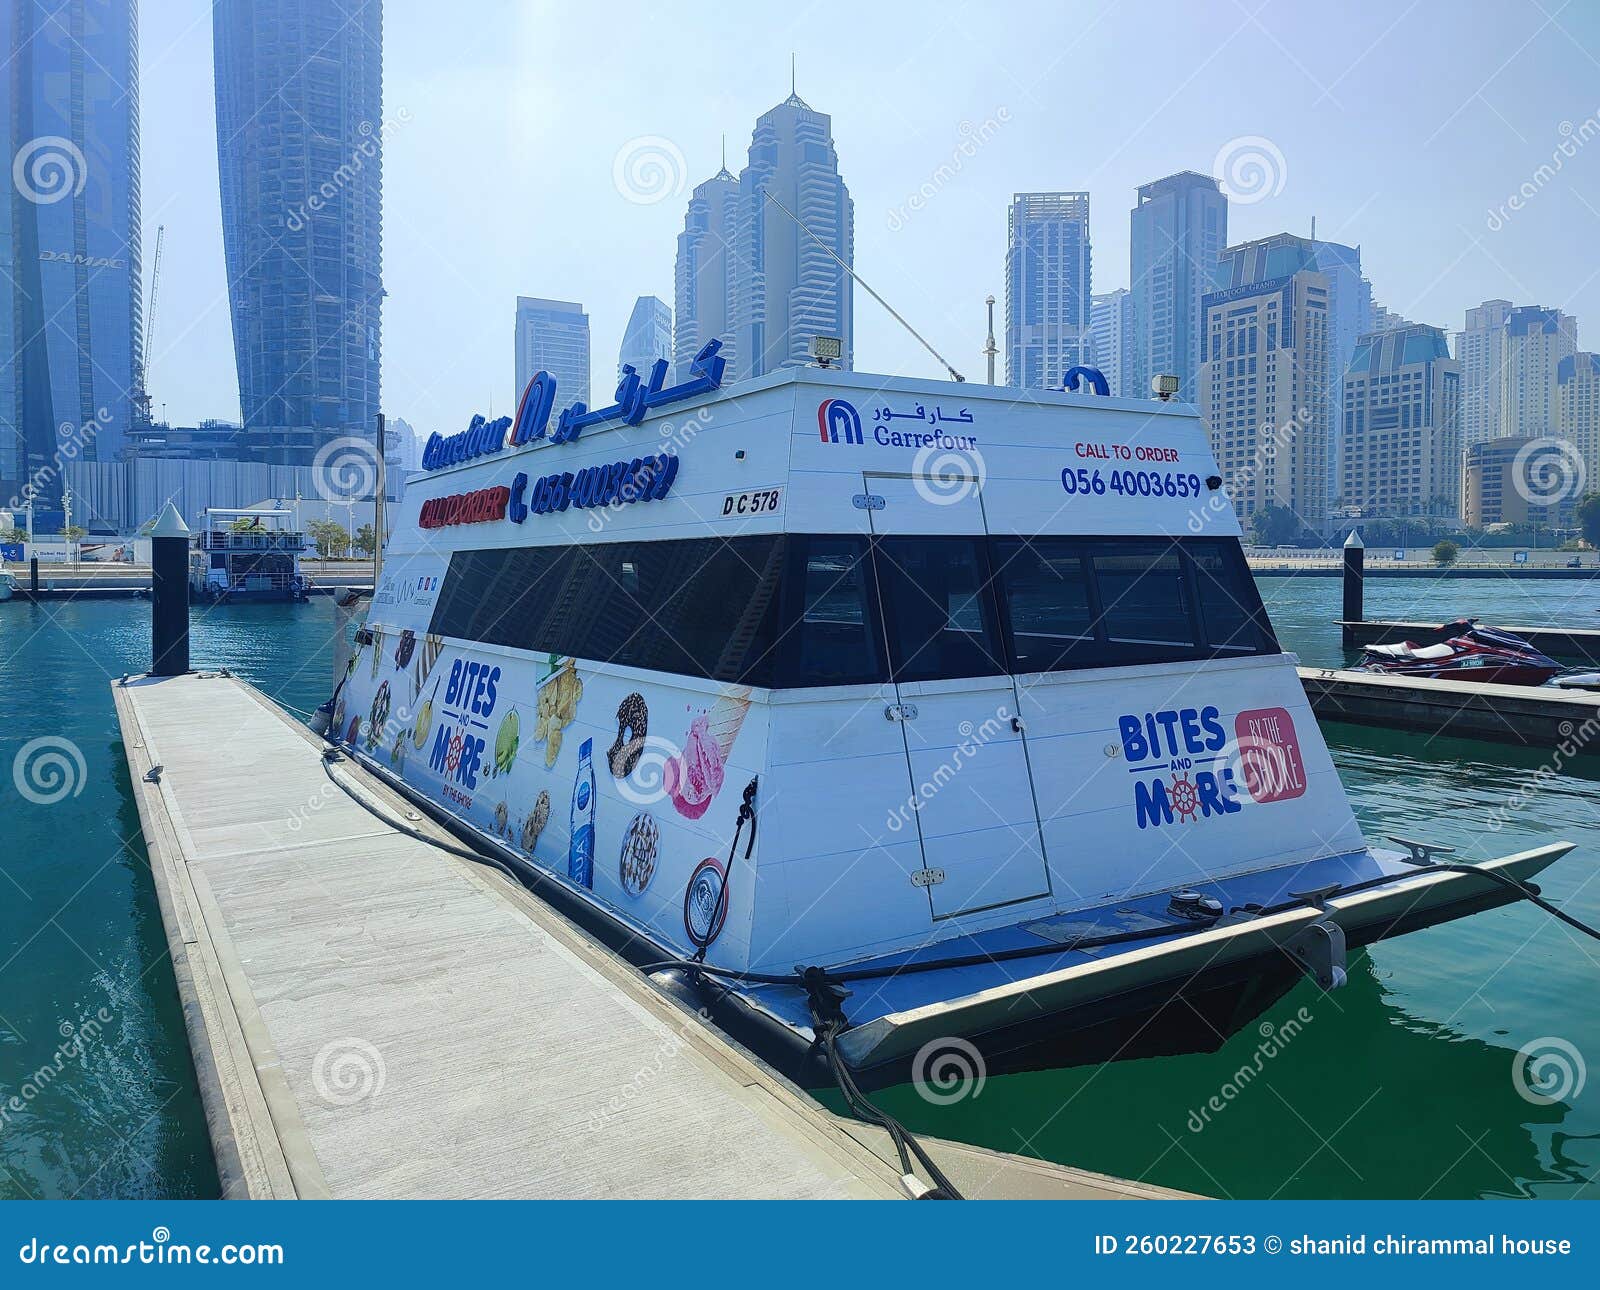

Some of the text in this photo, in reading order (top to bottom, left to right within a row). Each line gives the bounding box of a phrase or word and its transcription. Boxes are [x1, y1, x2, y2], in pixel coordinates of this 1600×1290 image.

[39, 250, 129, 269] DAMAC
[873, 402, 974, 424] كارفور
[874, 426, 977, 450] Carrefour
[1075, 443, 1180, 462] CALL TO ORDER
[531, 472, 574, 514] 056
[1061, 467, 1200, 498] 056 4003659
[751, 491, 779, 512] 578
[445, 659, 500, 718] BITES
[458, 714, 470, 727] AND
[1249, 716, 1283, 746] BY THE
[1119, 706, 1226, 762] BITES
[1171, 758, 1191, 771] AND
[1247, 745, 1302, 796] SHORE
